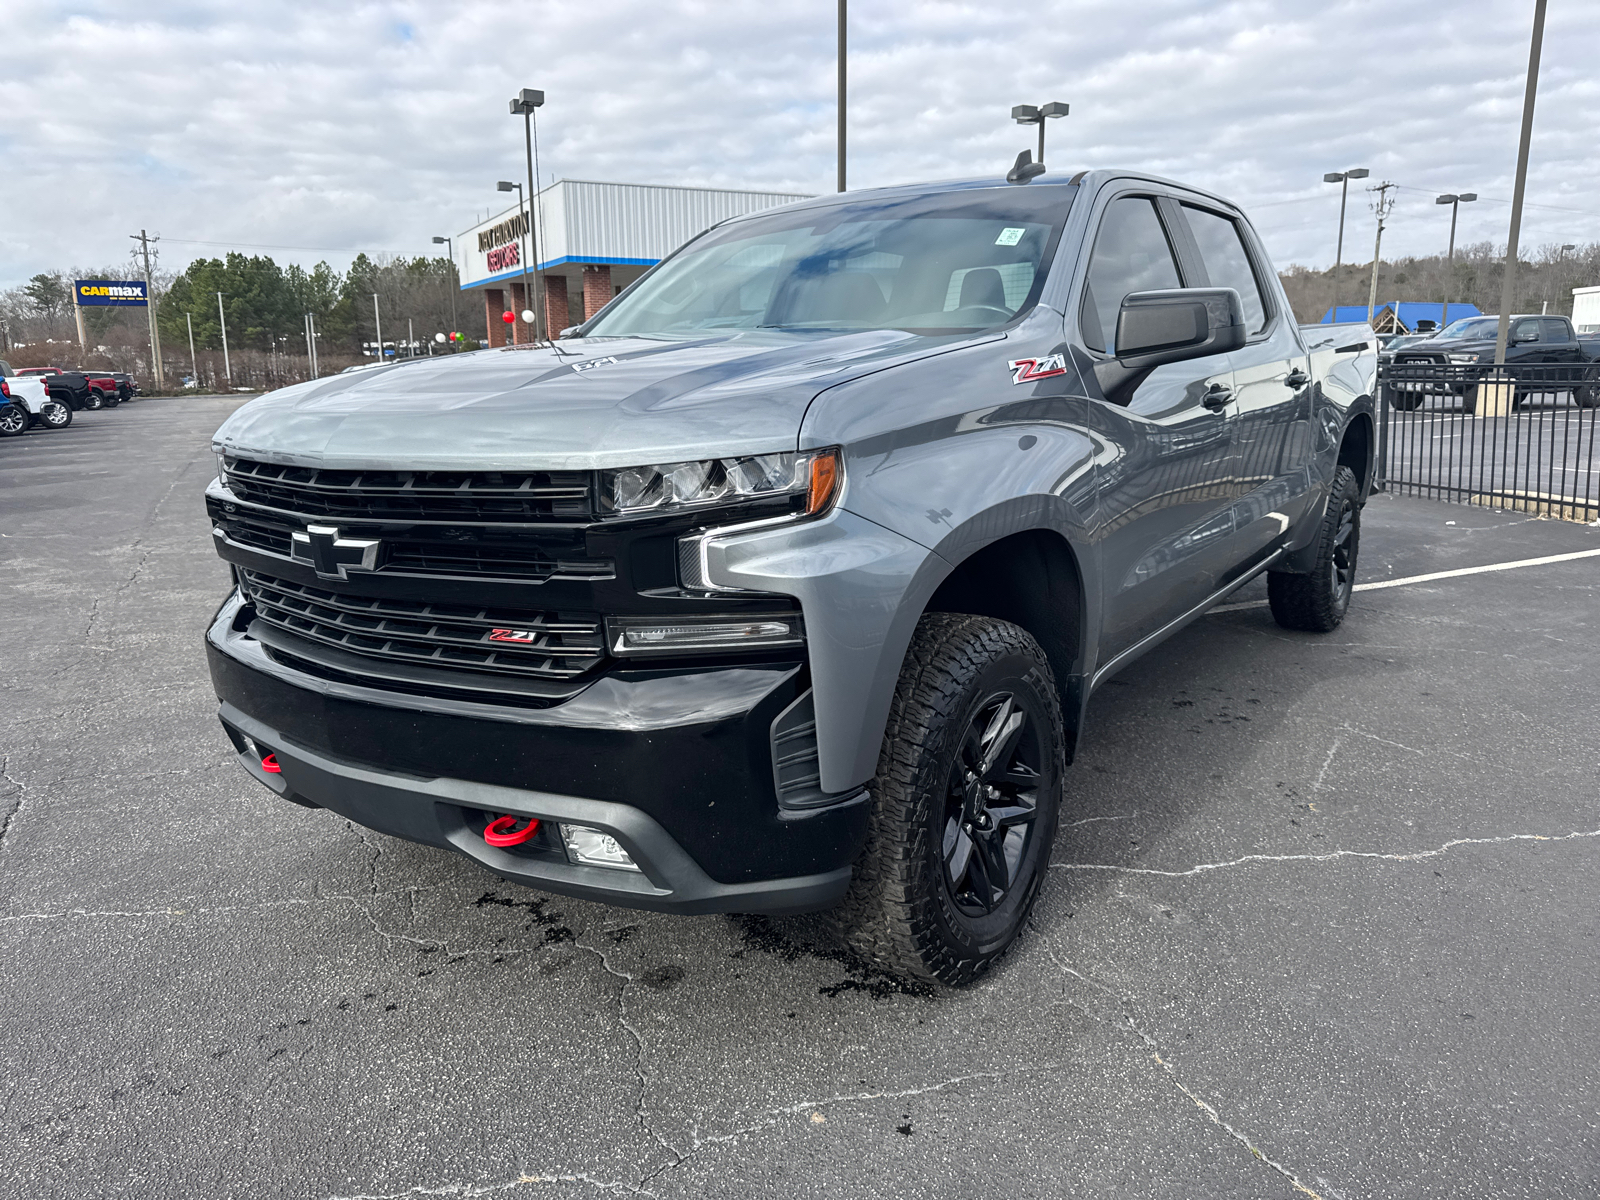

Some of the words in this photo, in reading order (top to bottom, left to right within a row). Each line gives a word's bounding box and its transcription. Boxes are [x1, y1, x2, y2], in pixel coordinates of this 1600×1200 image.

[487, 249, 503, 272] USED
[502, 242, 520, 267] CARS
[1008, 353, 1067, 385] Z71
[489, 628, 537, 644] Z71
